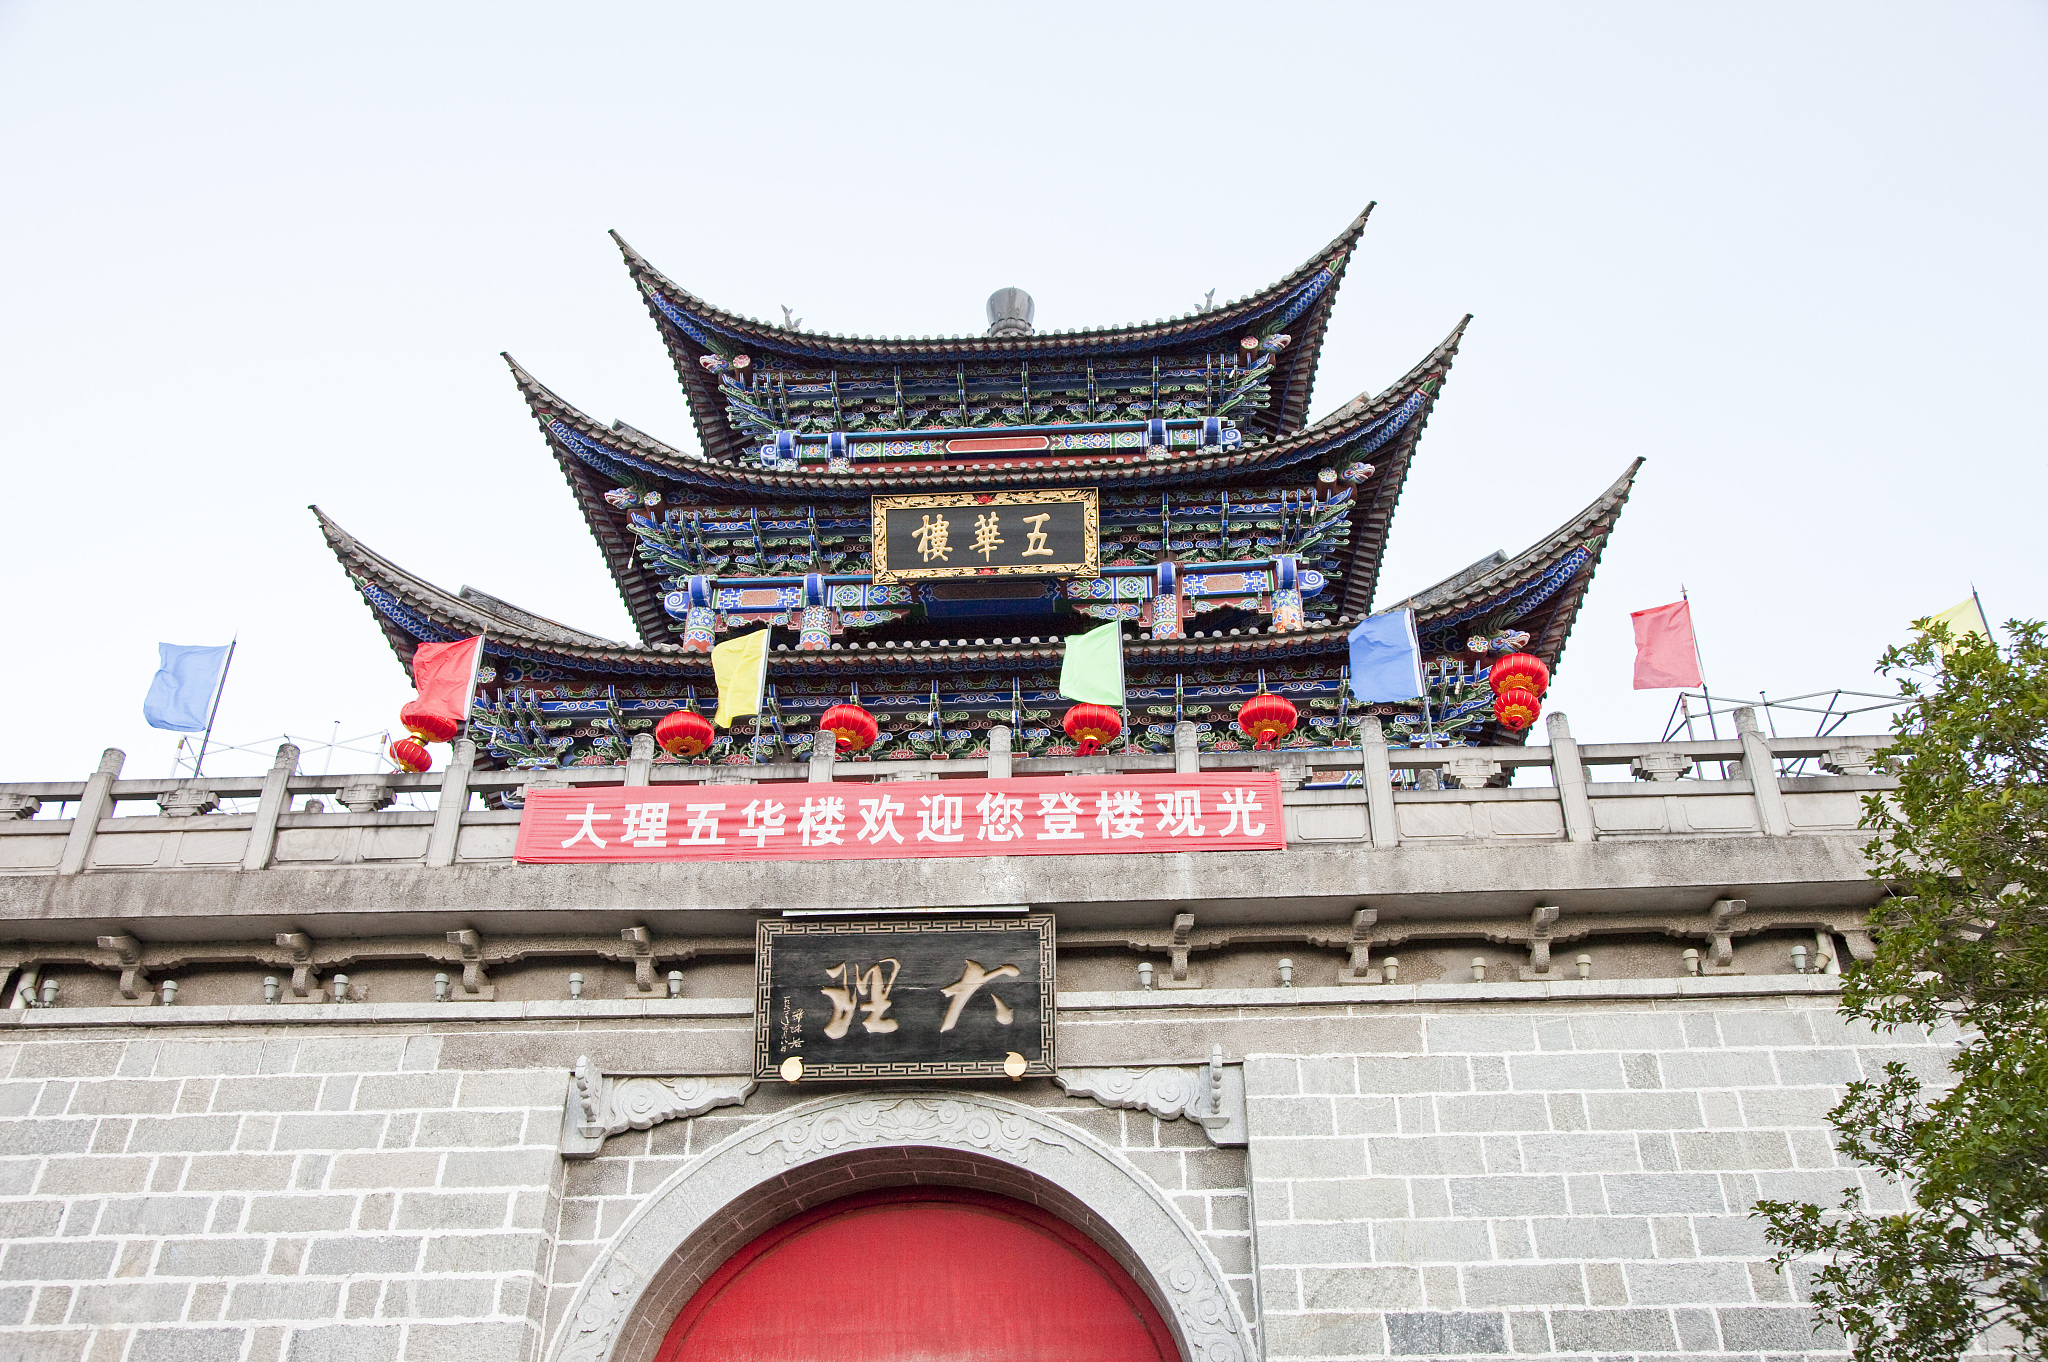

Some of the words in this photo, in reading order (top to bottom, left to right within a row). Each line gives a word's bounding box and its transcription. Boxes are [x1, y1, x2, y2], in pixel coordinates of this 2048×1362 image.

[561, 788, 1266, 849] 大理五华楼欢迎您登楼观光
